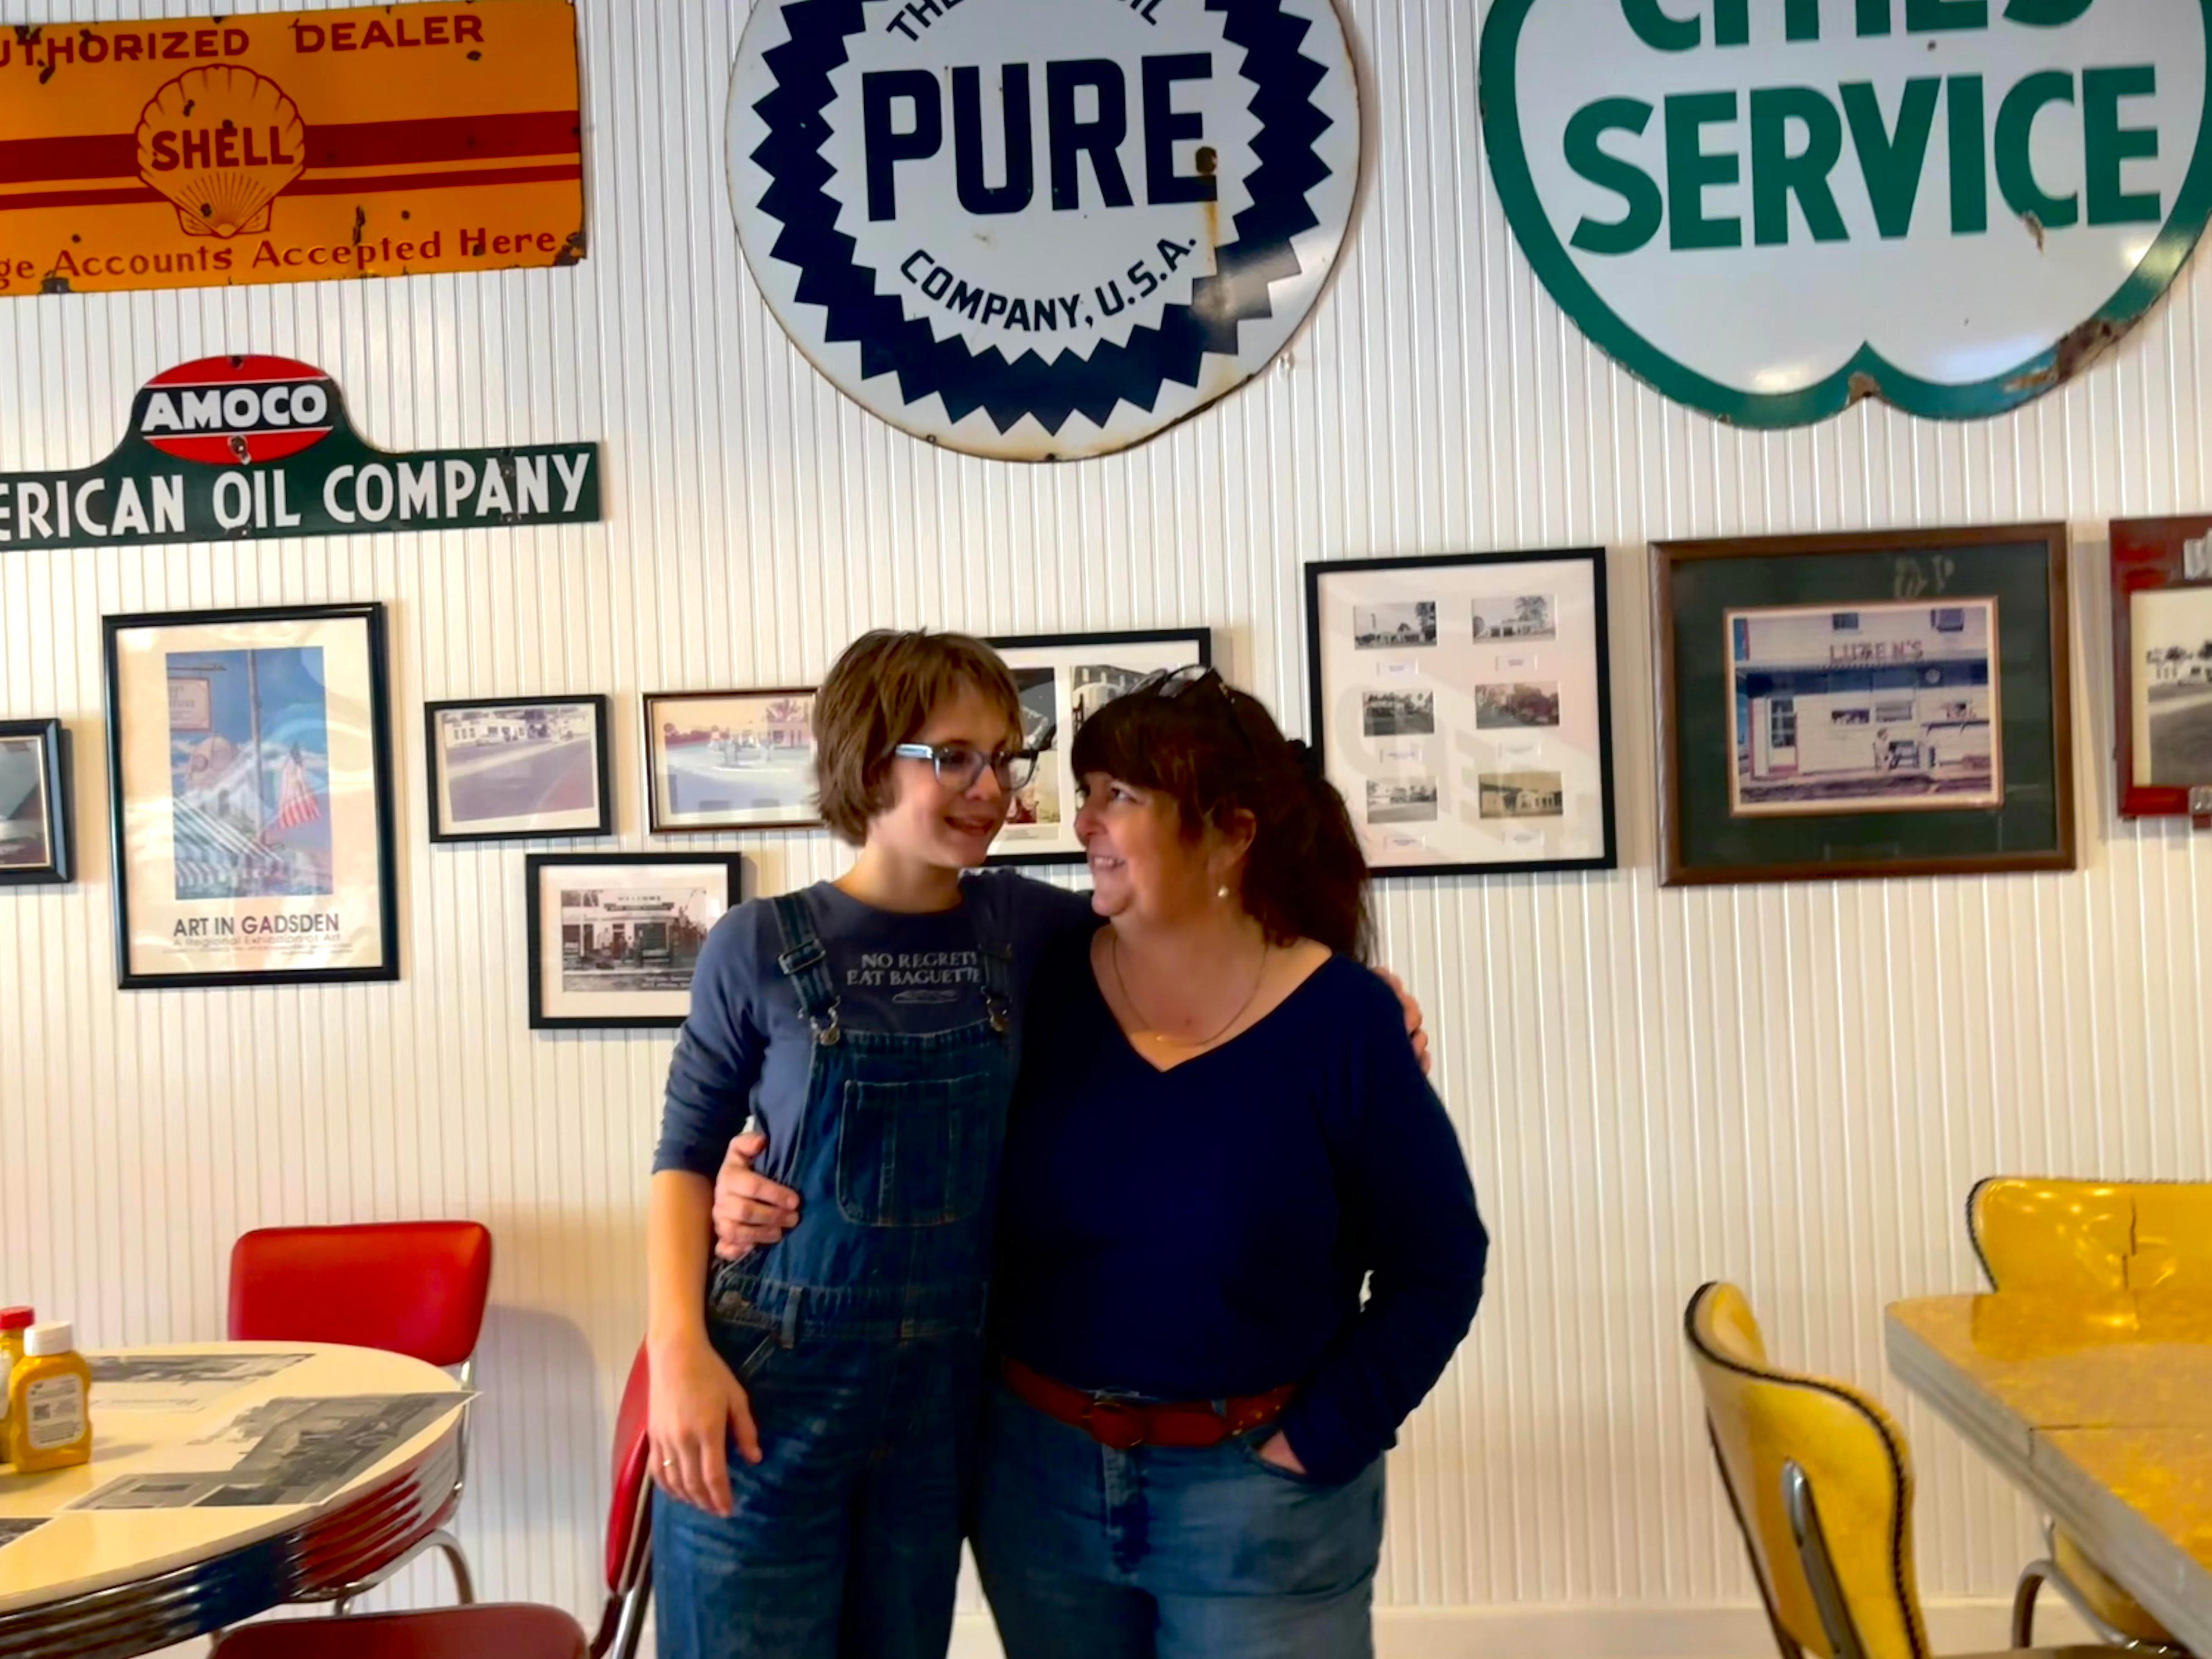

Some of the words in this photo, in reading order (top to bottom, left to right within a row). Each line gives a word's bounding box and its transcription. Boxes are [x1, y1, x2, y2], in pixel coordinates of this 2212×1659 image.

[295, 15, 484, 53] DEALER
[885, 0, 965, 42] TH
[151, 126, 294, 171] SHELL
[862, 52, 1218, 221] PURE
[1563, 65, 2162, 256] SERVICE
[52, 245, 232, 277] Accounts
[252, 230, 441, 270] Accepted
[460, 228, 557, 256] Here
[900, 249, 1094, 332] COMPANY,
[1095, 236, 1198, 316] U.S.A.
[141, 385, 327, 431] AMOCO
[213, 470, 301, 529] OIL
[324, 453, 590, 523] COMPANY
[173, 918, 209, 937] ART
[215, 917, 234, 935] IN
[242, 913, 339, 935] GADSDEN
[846, 968, 885, 986] EAT
[861, 952, 894, 968] NO
